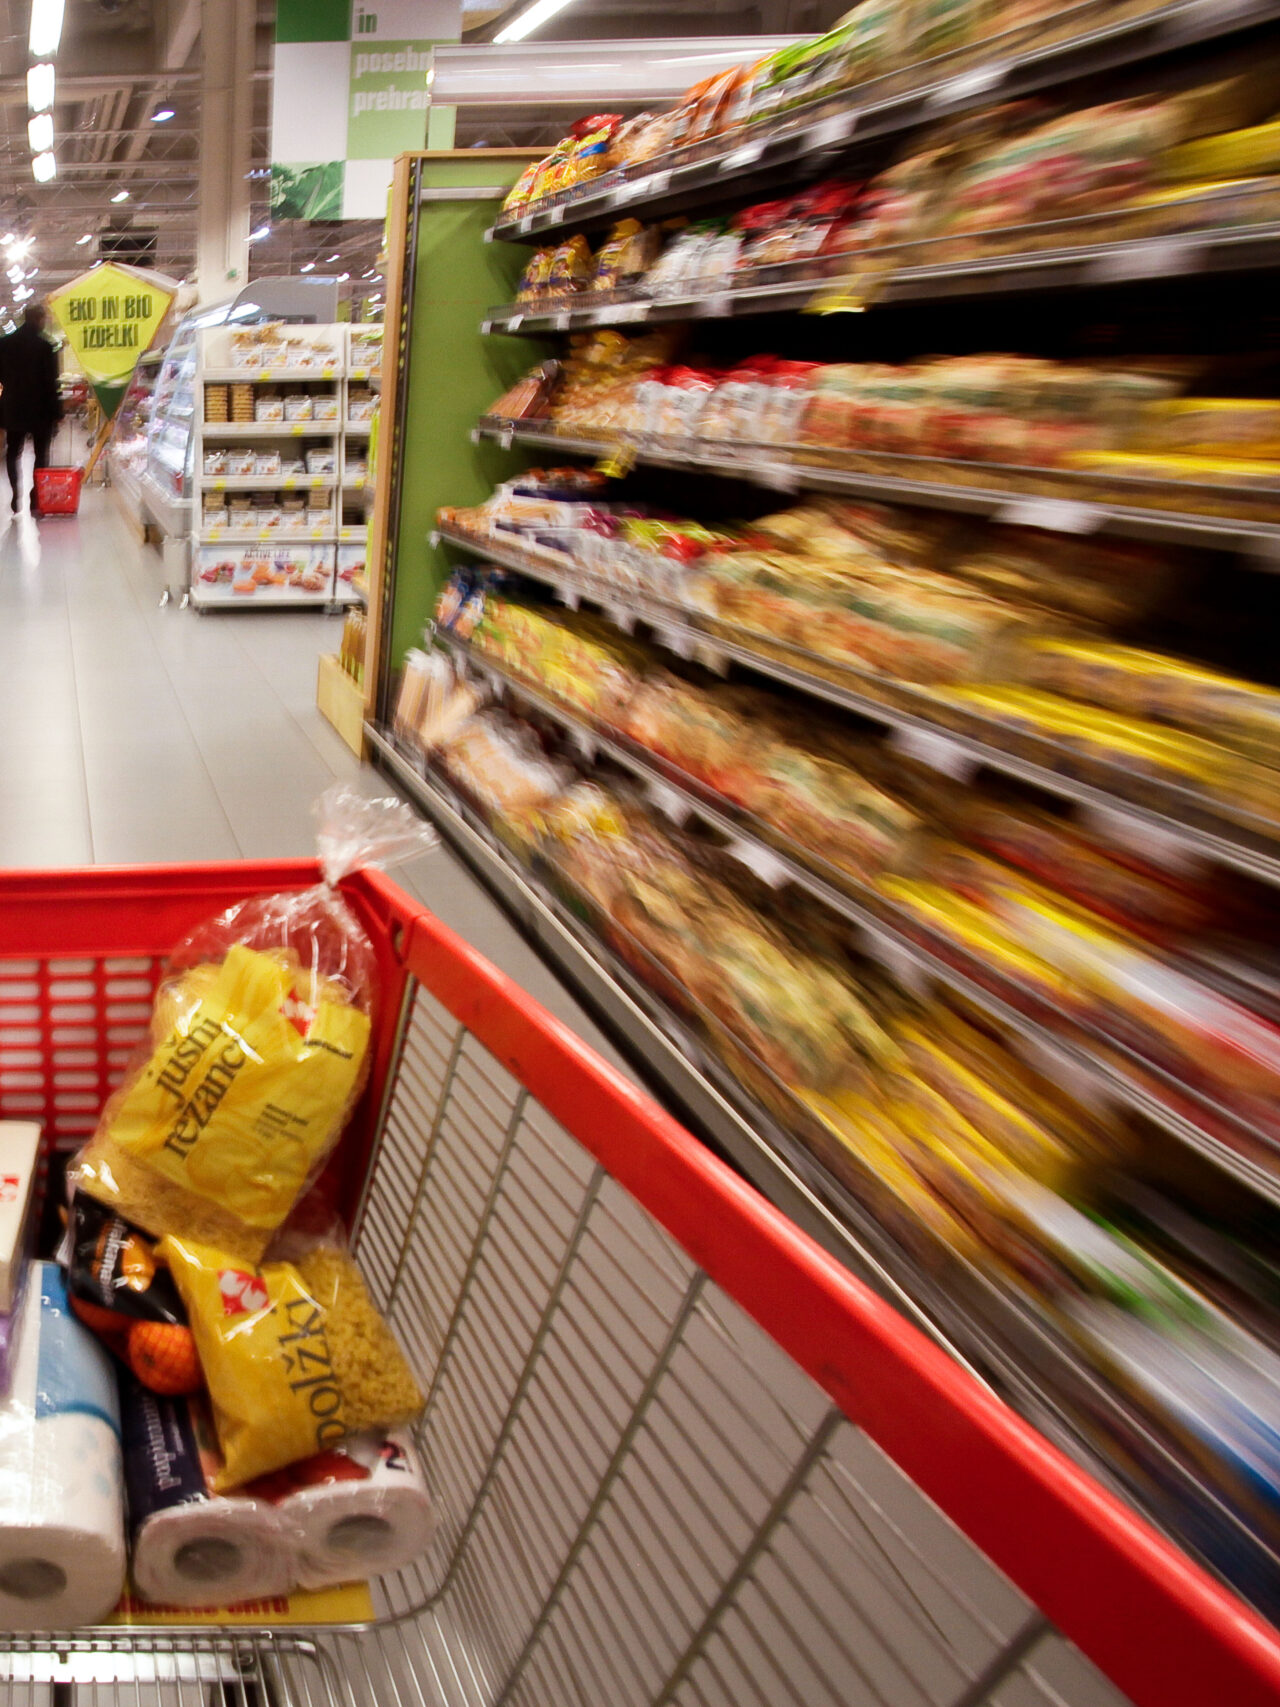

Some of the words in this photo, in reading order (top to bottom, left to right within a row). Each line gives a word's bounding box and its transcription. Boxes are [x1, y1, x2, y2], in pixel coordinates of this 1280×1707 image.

[357, 8, 377, 33] in
[355, 45, 433, 78] posebn
[69, 297, 97, 321] EKO
[102, 295, 119, 319] IN
[125, 294, 152, 319] BIO
[83, 324, 138, 348] IZDELKI
[147, 1011, 224, 1108] jušni
[271, 1296, 360, 1450] polžki
